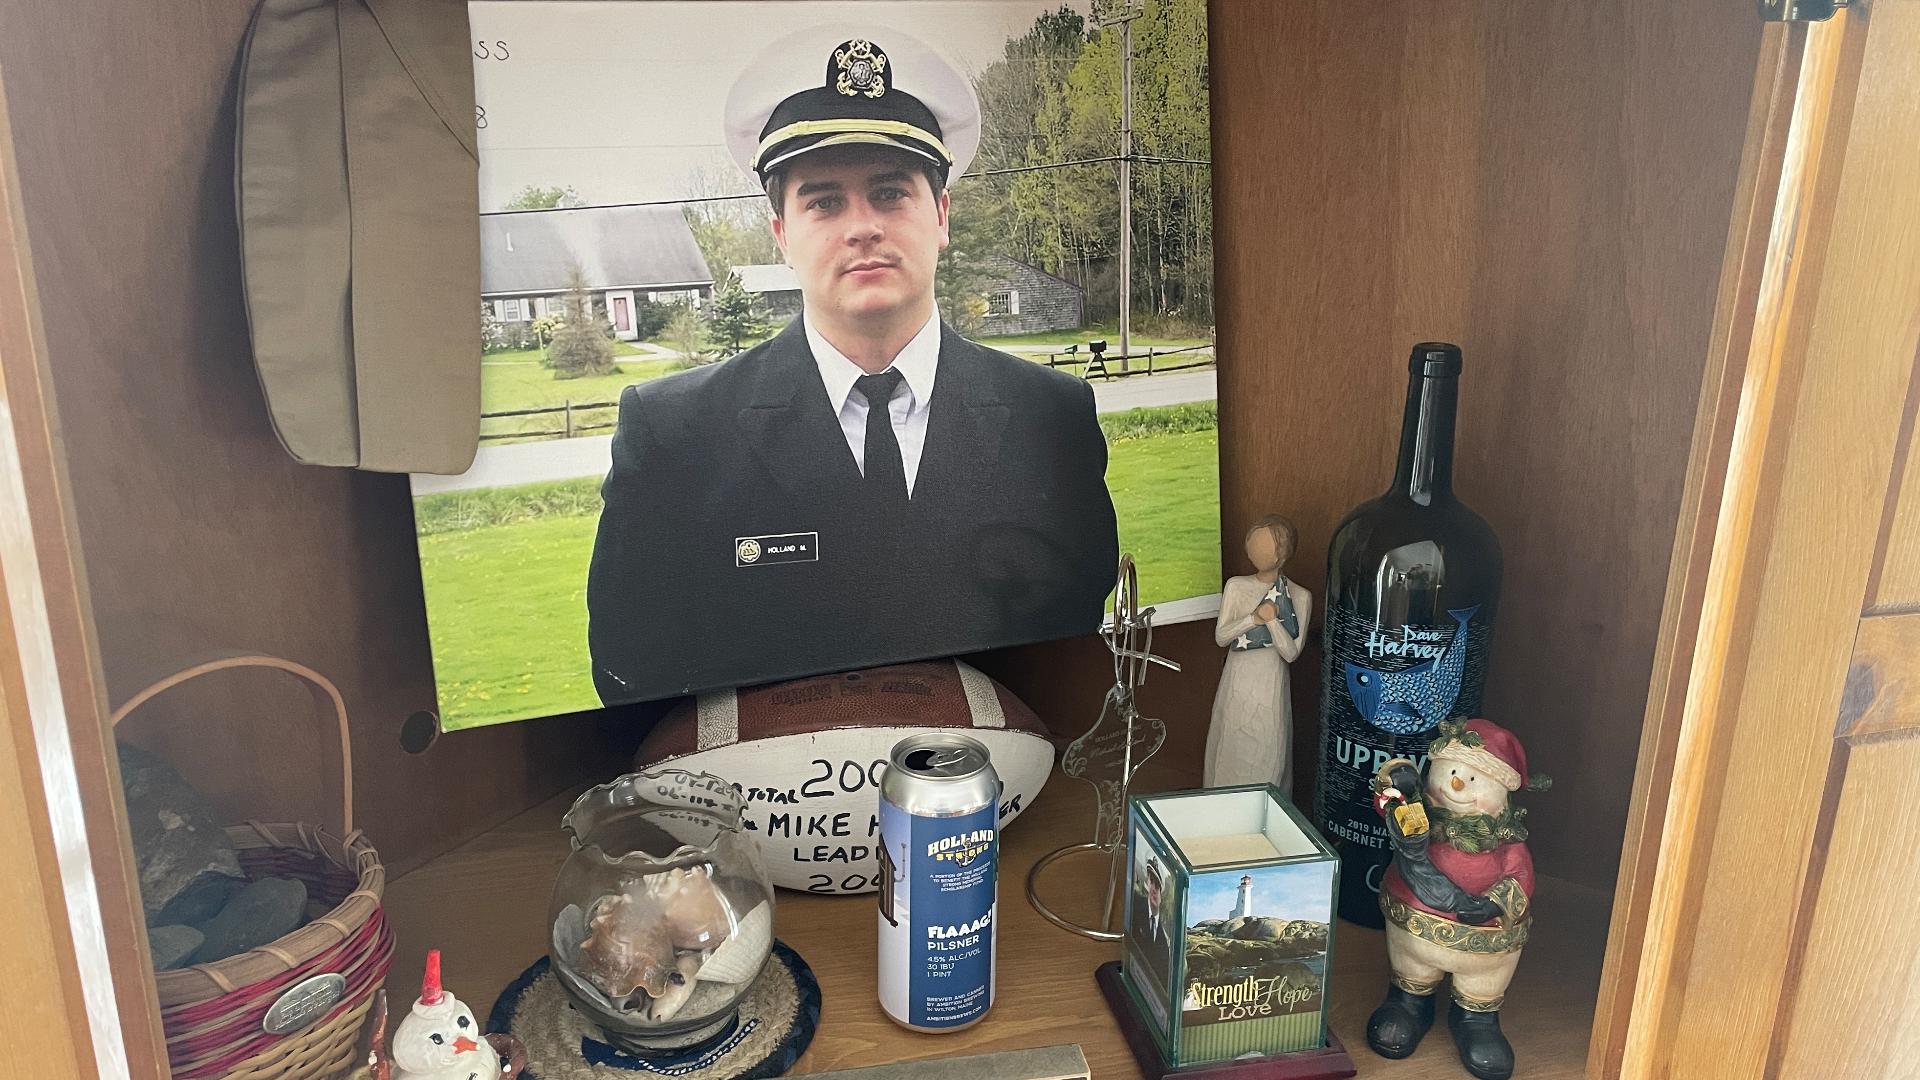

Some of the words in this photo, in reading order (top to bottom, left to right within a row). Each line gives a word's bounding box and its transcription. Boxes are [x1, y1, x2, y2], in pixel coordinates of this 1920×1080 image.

[767, 545, 796, 554] HOLLAND
[1401, 624, 1443, 642] Dave
[1364, 631, 1447, 673] Harvey
[1336, 735, 1429, 775] UPRV
[801, 759, 889, 797] 200
[768, 812, 851, 838] MIKE
[1328, 820, 1385, 849] CABERNET
[1347, 818, 1369, 833] 2019
[794, 845, 879, 863] LEAD
[927, 829, 994, 857] HOLLAND
[927, 908, 992, 939] FLAAAG!
[927, 935, 980, 951] PILSNER
[940, 962, 955, 970] IBU
[1191, 975, 1259, 1008] Strength
[1254, 975, 1313, 1013] Hope
